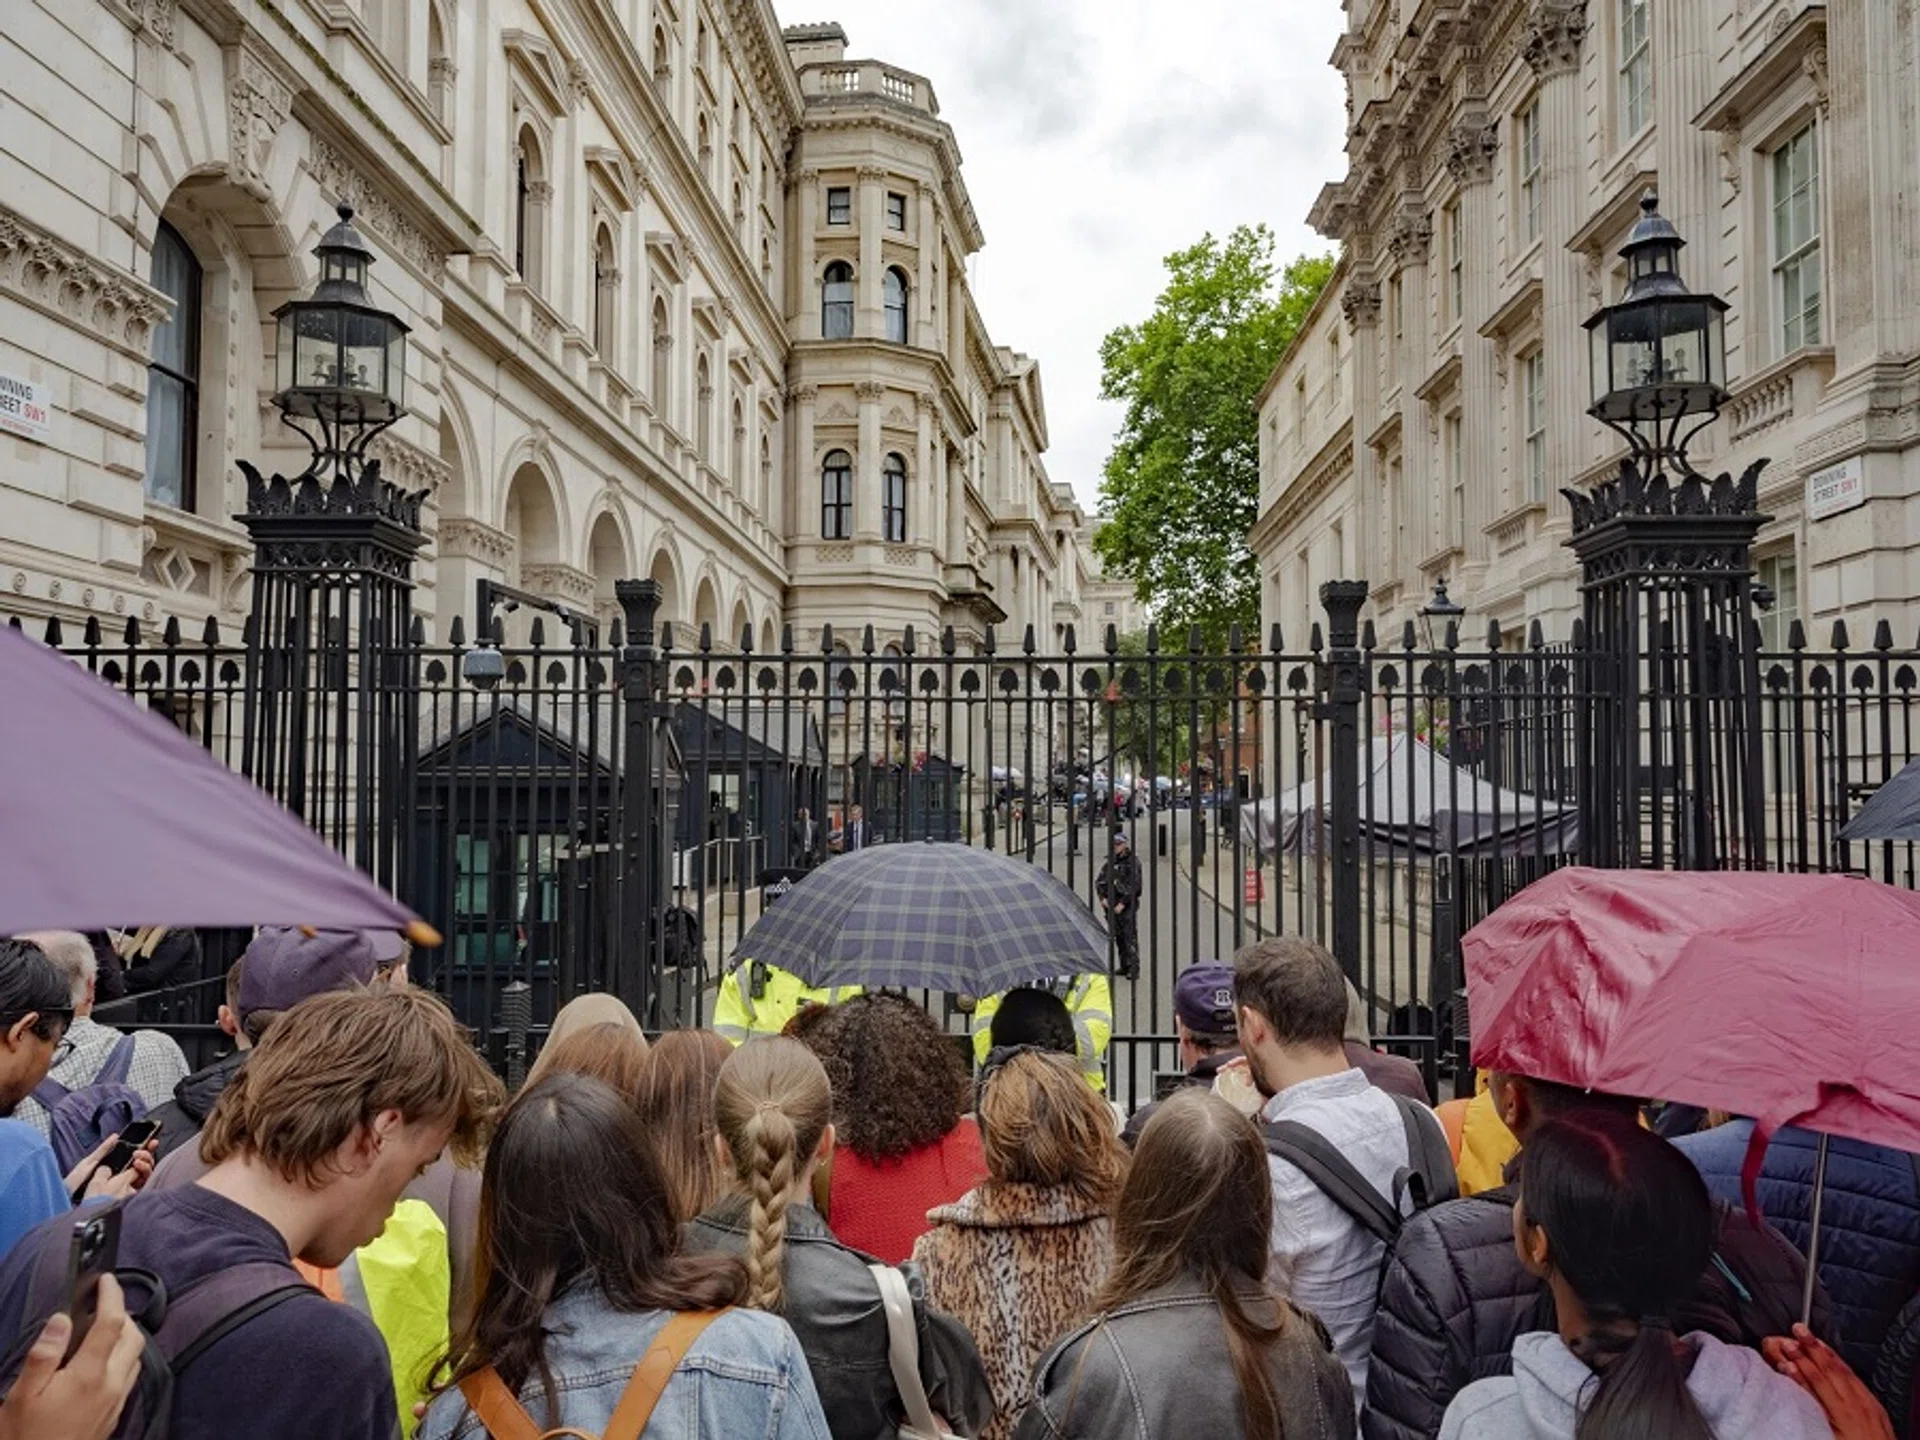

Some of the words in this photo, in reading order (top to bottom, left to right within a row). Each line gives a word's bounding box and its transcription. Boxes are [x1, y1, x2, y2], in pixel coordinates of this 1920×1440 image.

[24, 403, 46, 424] SW1
[1813, 484, 1839, 503] STREET
[1841, 478, 1858, 494] SW1
